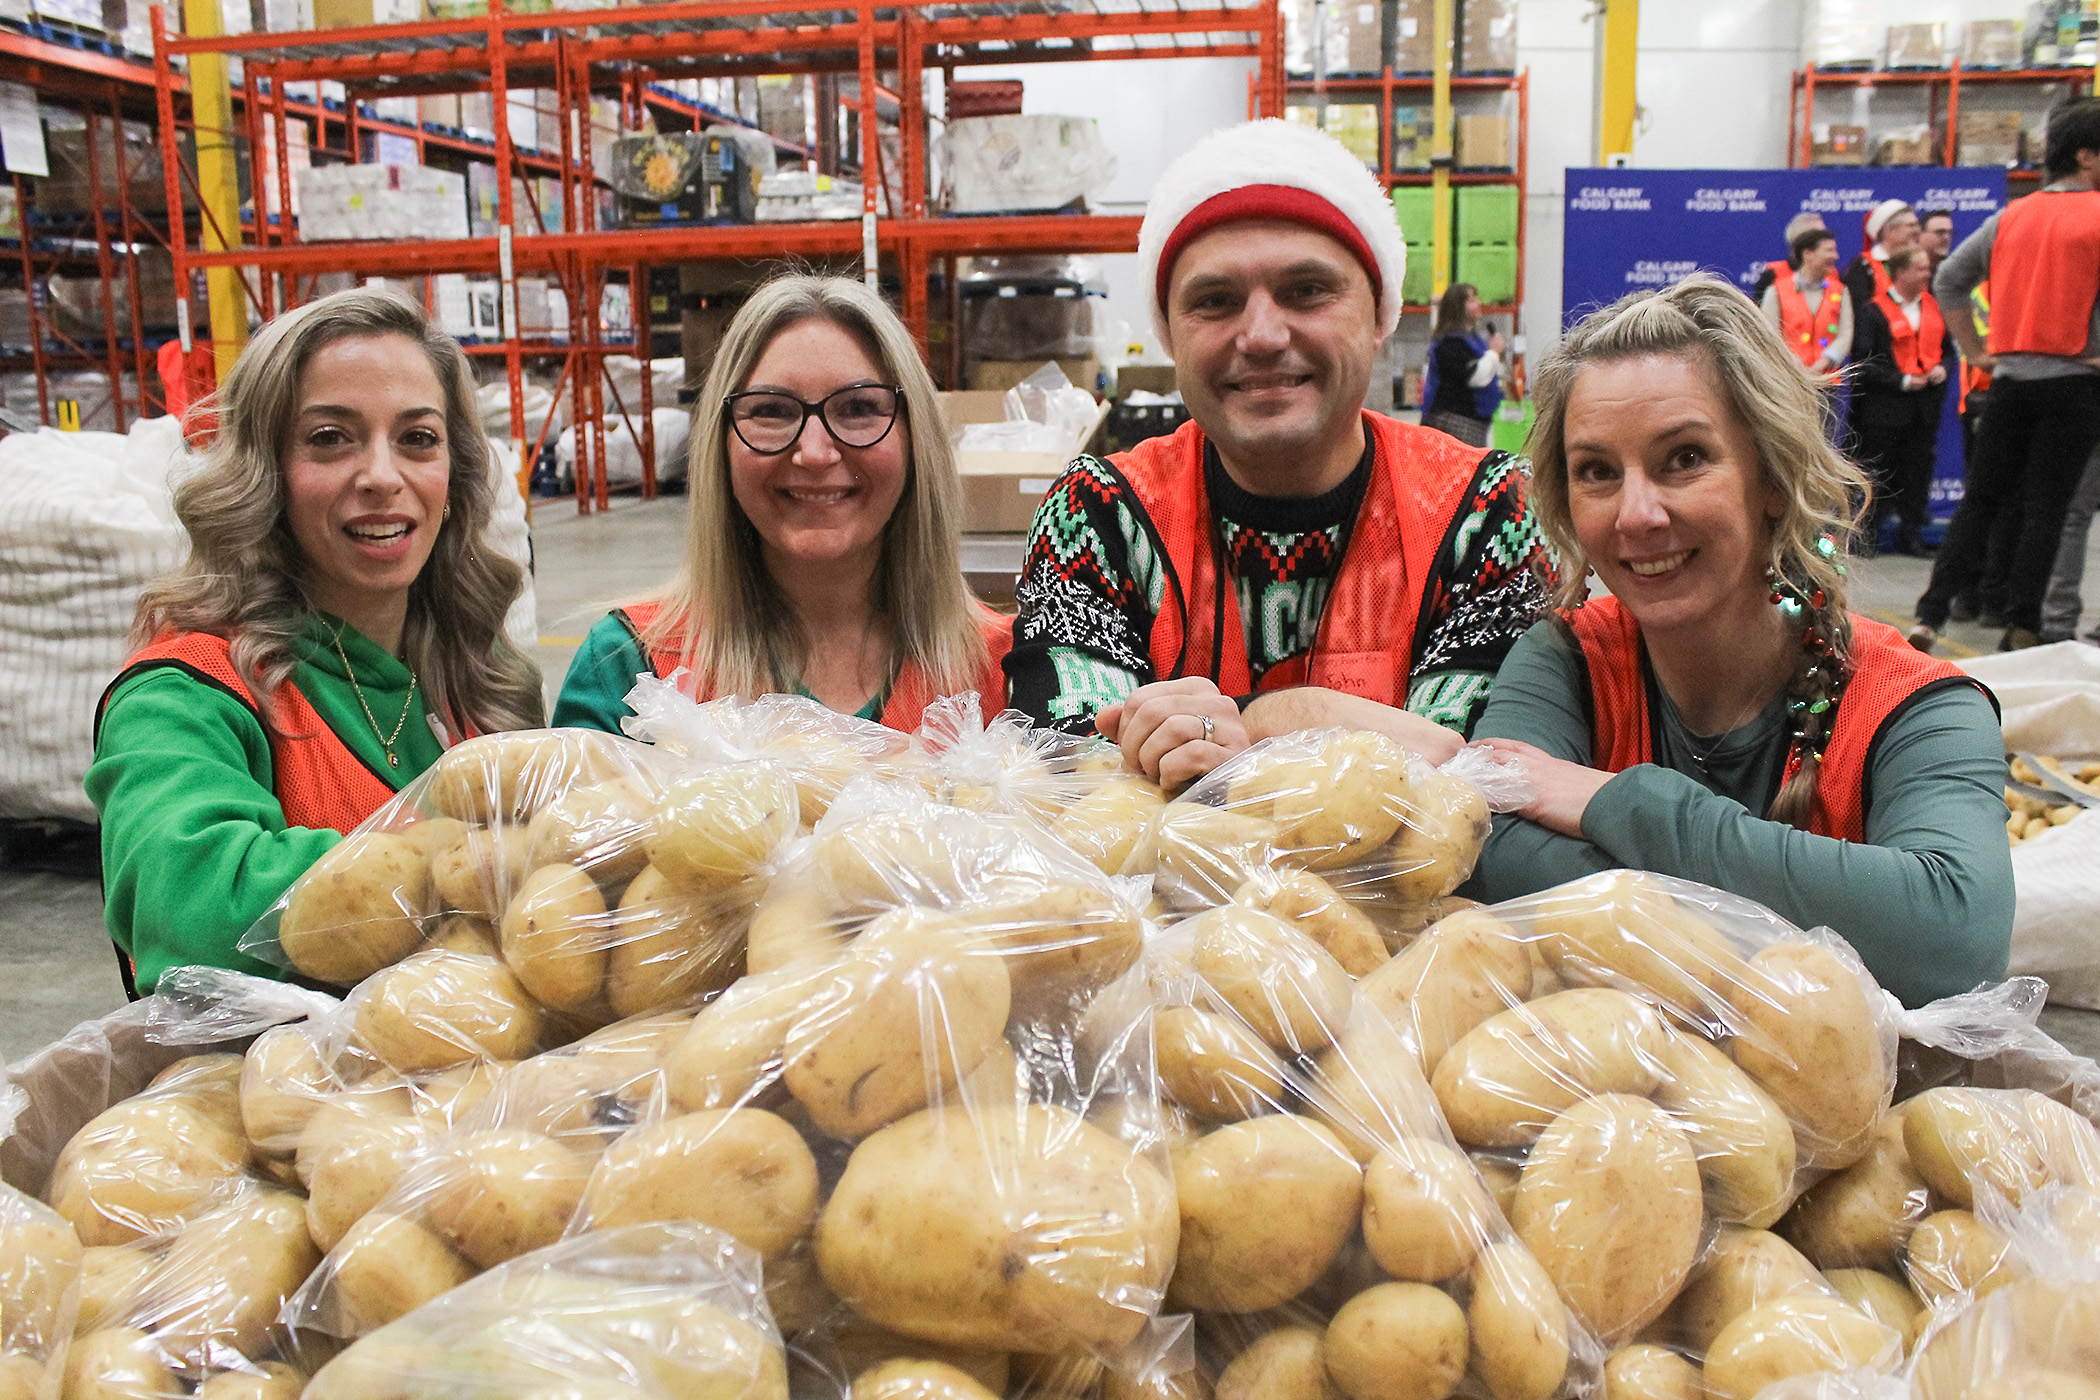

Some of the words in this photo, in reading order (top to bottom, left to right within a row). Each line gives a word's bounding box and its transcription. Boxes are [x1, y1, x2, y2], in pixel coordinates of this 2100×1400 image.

[1580, 187, 1643, 199] CALGARY
[1694, 188, 1758, 200] CALGARY
[1809, 188, 1875, 200] CALGARY
[1925, 187, 1989, 200] CALGARY
[1571, 198, 1611, 211] FOOD
[1613, 199, 1651, 211] BANK
[1686, 199, 1727, 212] FOOD
[1728, 200, 1766, 212] BANK
[1800, 199, 1841, 212] FOOD
[1915, 199, 1956, 212] FOOD
[1959, 199, 1997, 212] BANK
[1634, 260, 1698, 272] CALGARY
[1625, 271, 1665, 284] FOOD
